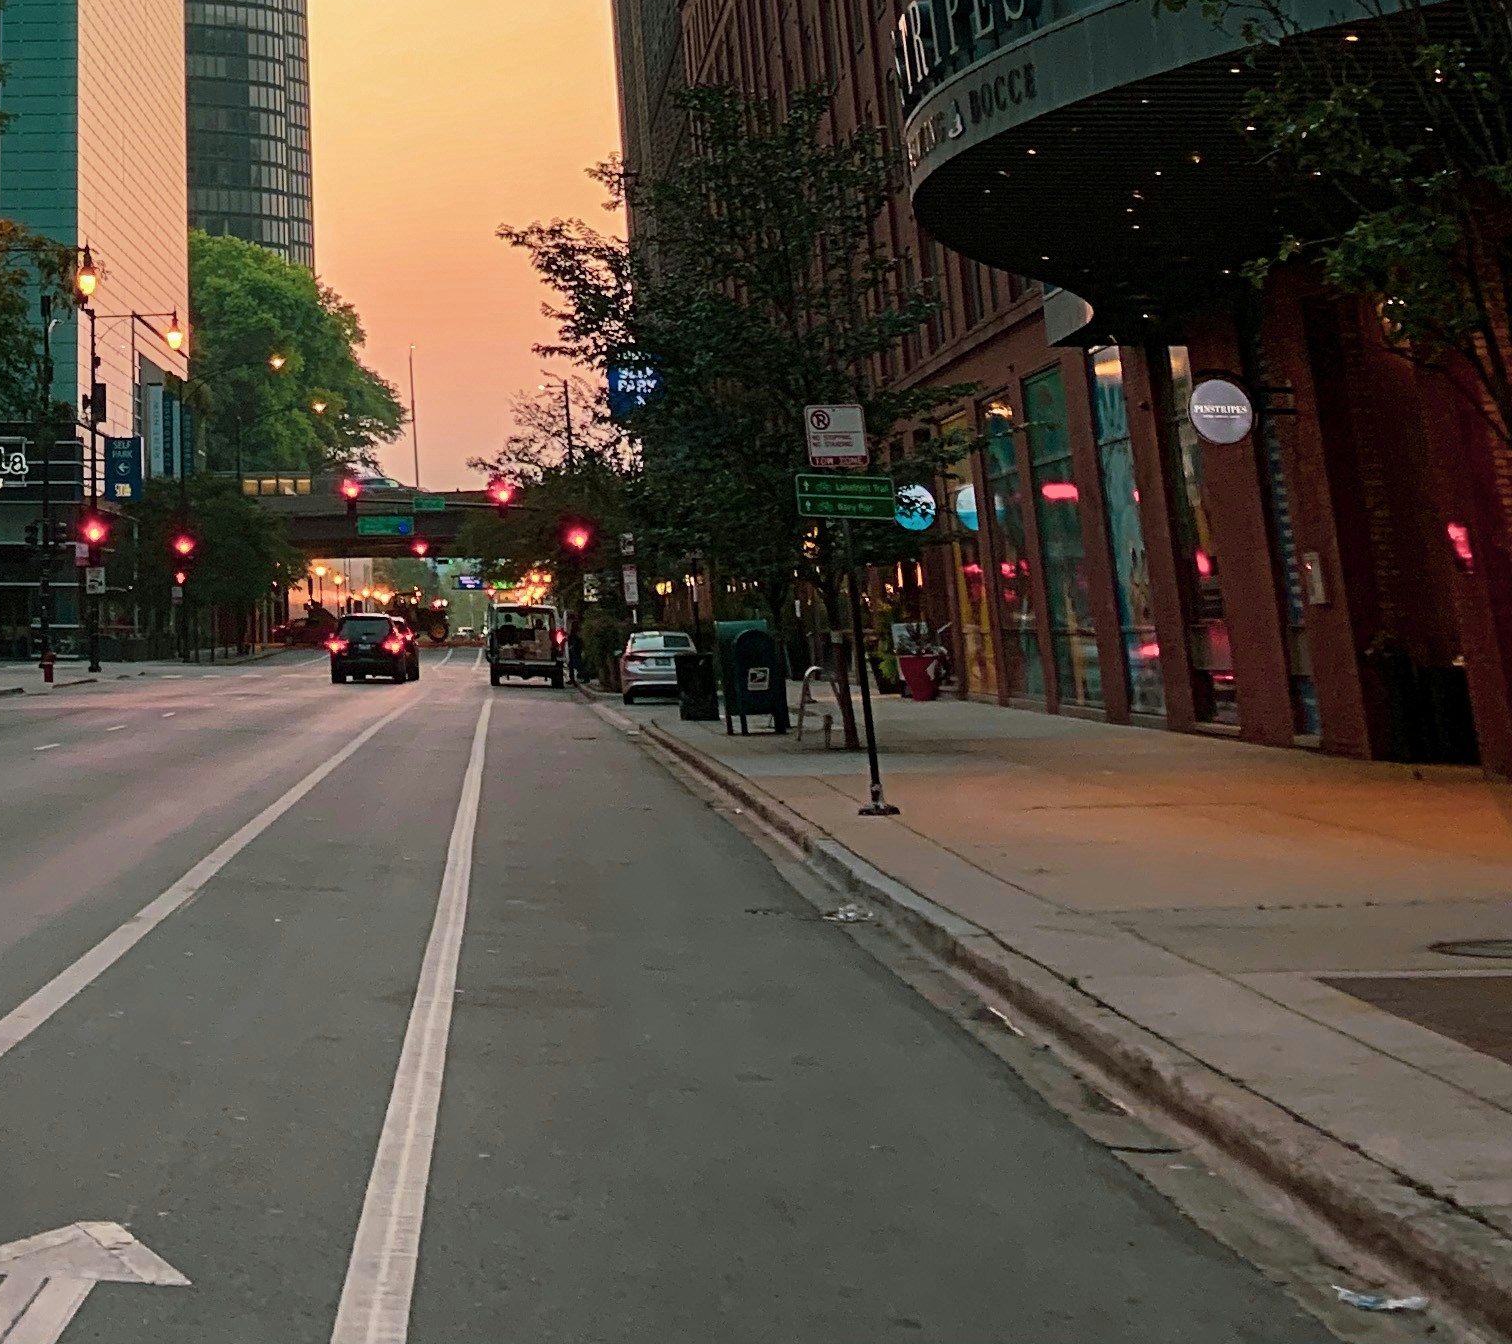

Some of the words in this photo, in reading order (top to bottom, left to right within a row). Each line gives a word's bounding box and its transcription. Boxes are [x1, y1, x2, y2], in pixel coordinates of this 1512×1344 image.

[1193, 404, 1248, 414] PINSTRIPES
[112, 440, 132, 449] SELF
[112, 450, 133, 459] PARK
[814, 457, 834, 465] TOW
[838, 456, 864, 465] ZONE
